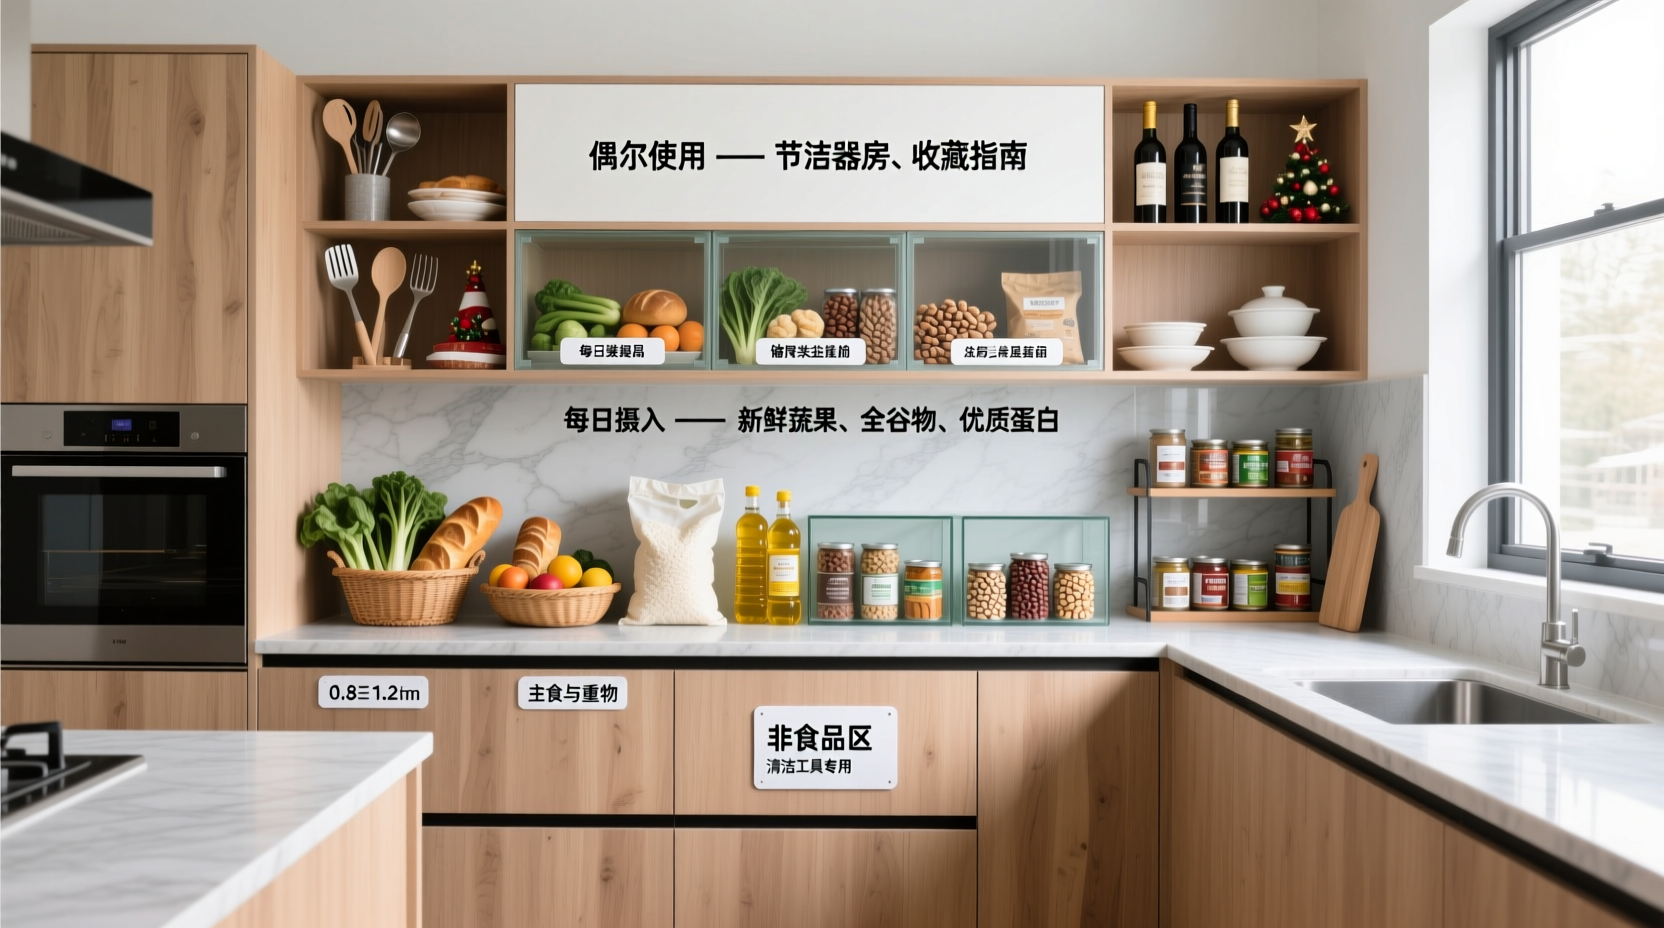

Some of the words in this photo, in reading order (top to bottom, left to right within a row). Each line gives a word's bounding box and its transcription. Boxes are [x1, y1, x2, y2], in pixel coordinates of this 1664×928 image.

[588, 139, 705, 172] 偶尔使用
[563, 405, 666, 434] 每日摄入
[528, 683, 618, 703] 主食与重物
[767, 723, 873, 752] 非食品区
[766, 758, 852, 775] 清洁工具专用
